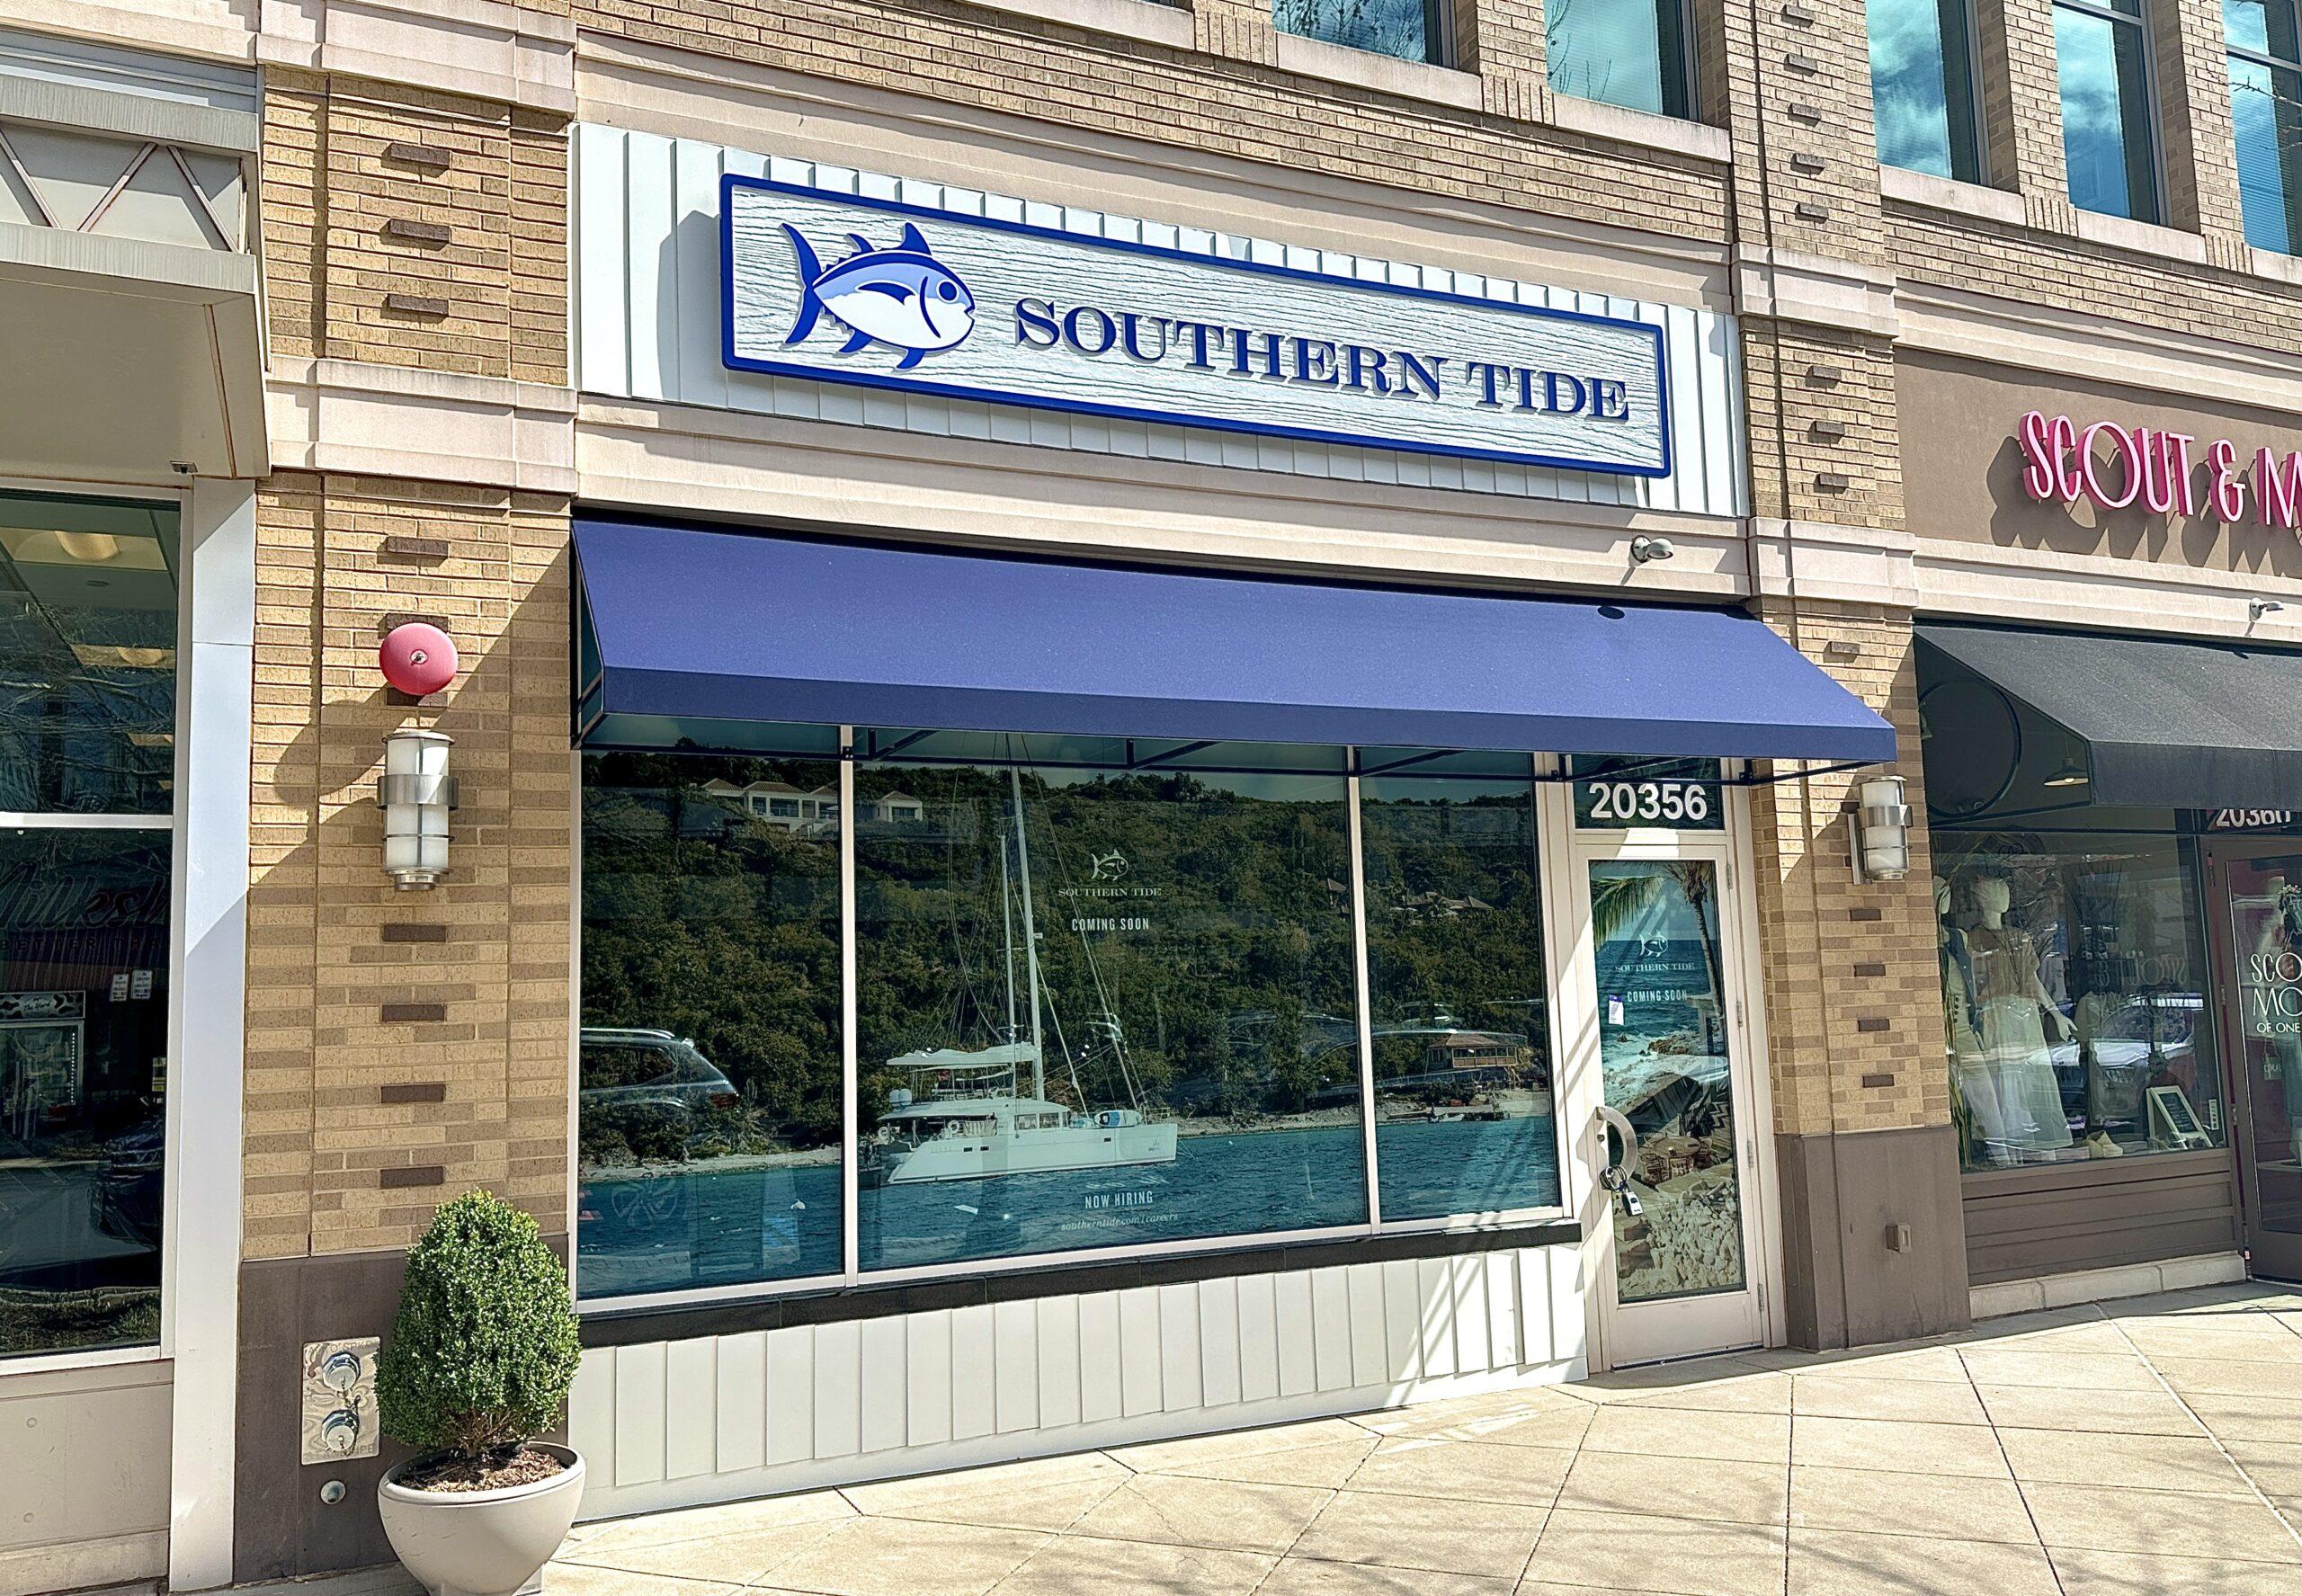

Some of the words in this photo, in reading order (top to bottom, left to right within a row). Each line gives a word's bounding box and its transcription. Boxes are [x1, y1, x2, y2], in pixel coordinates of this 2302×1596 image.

[1014, 298, 1449, 401] SOUTHERN
[1467, 362, 1628, 422] TIDE
[2019, 410, 2195, 516] SCOUT
[2208, 439, 2245, 523] &
[1589, 783, 1707, 820] 20356
[1058, 887, 1128, 897] SOUTHERN
[1131, 887, 1162, 896] TIDE
[1072, 917, 1115, 932] COMING
[1120, 917, 1149, 931] SOON
[1614, 963, 1669, 973] SOUTHERN
[1671, 962, 1695, 971] TIDE
[2251, 952, 2302, 982] SCO
[1628, 990, 1662, 1003] COMING
[1664, 989, 1687, 1002] SOON
[2253, 987, 2302, 1017] MO
[2256, 1022, 2272, 1033] OF
[2276, 1021, 2301, 1033] ONE
[1084, 1194, 1110, 1209] NOW
[1114, 1190, 1153, 1206] HIRING
[1060, 1214, 1179, 1231] southerntide.com/careers
